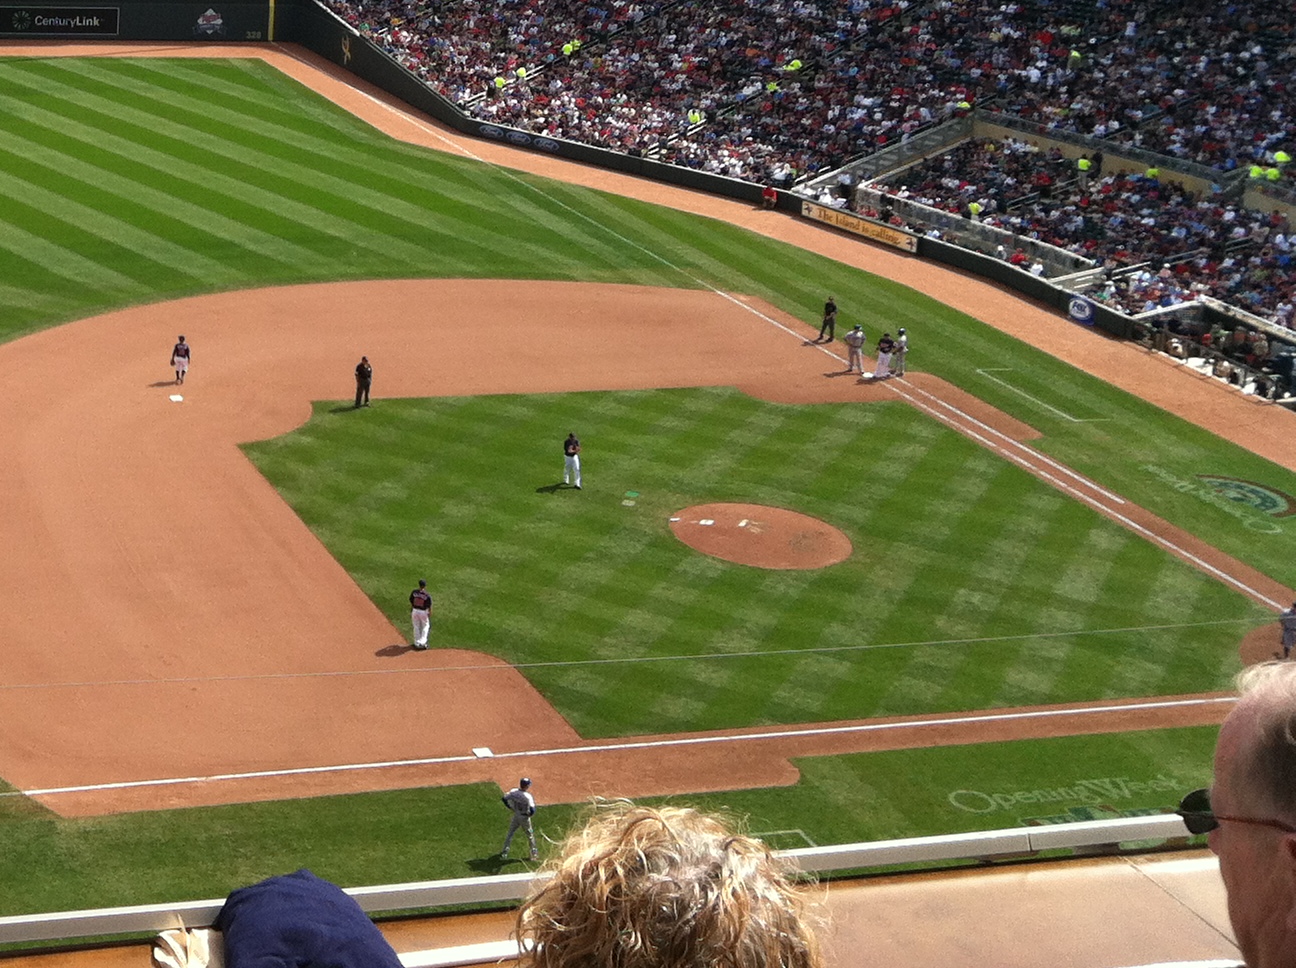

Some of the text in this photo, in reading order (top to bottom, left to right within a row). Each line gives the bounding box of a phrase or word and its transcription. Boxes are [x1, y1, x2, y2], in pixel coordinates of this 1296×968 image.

[34, 15, 100, 28] CenturyLink
[817, 207, 833, 222] The
[835, 213, 860, 231] Island
